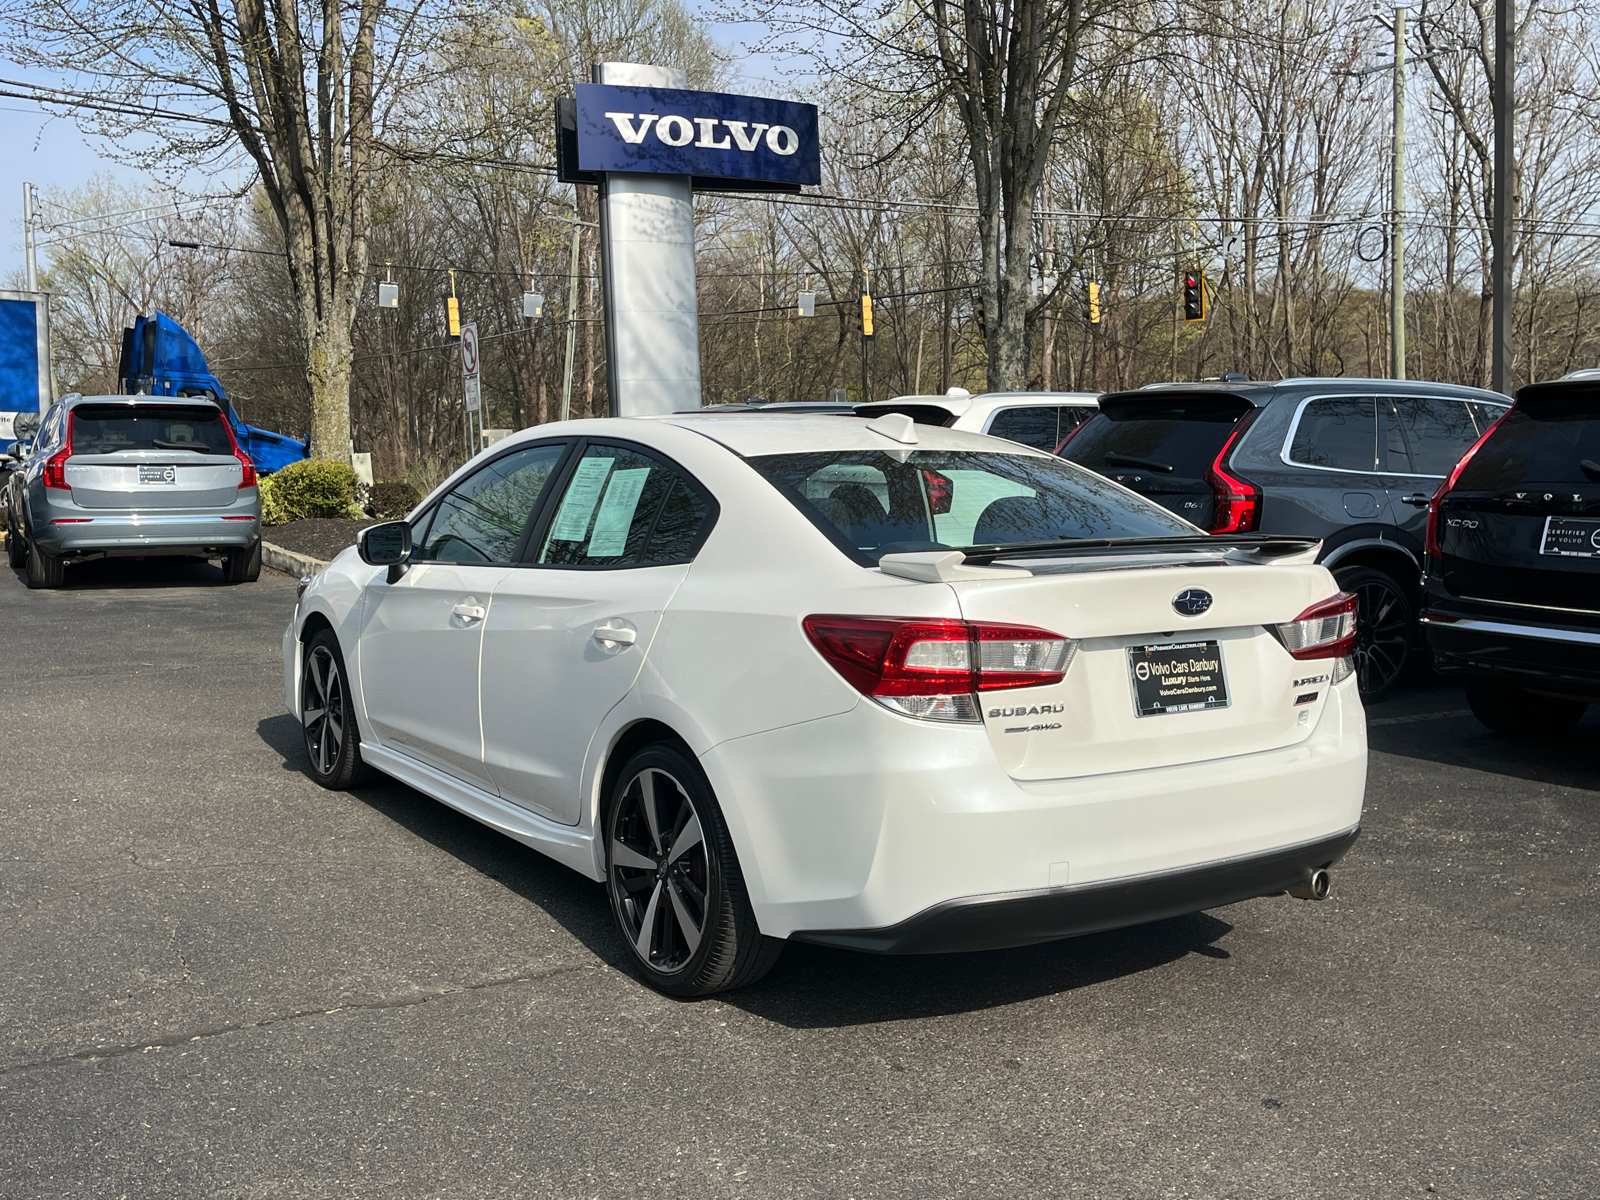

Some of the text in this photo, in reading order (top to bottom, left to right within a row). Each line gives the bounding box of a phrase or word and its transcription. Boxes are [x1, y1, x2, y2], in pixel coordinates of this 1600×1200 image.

[605, 112, 799, 155] VOLVO
[1446, 518, 1479, 529] XC90
[1149, 658, 1219, 676] Volvo Cars Danbury
[1161, 675, 1186, 686] Luxury
[1159, 685, 1217, 696] VolvoCarsDanbury.com
[988, 704, 1065, 718] SUBARU
[1026, 723, 1062, 732] AWD
